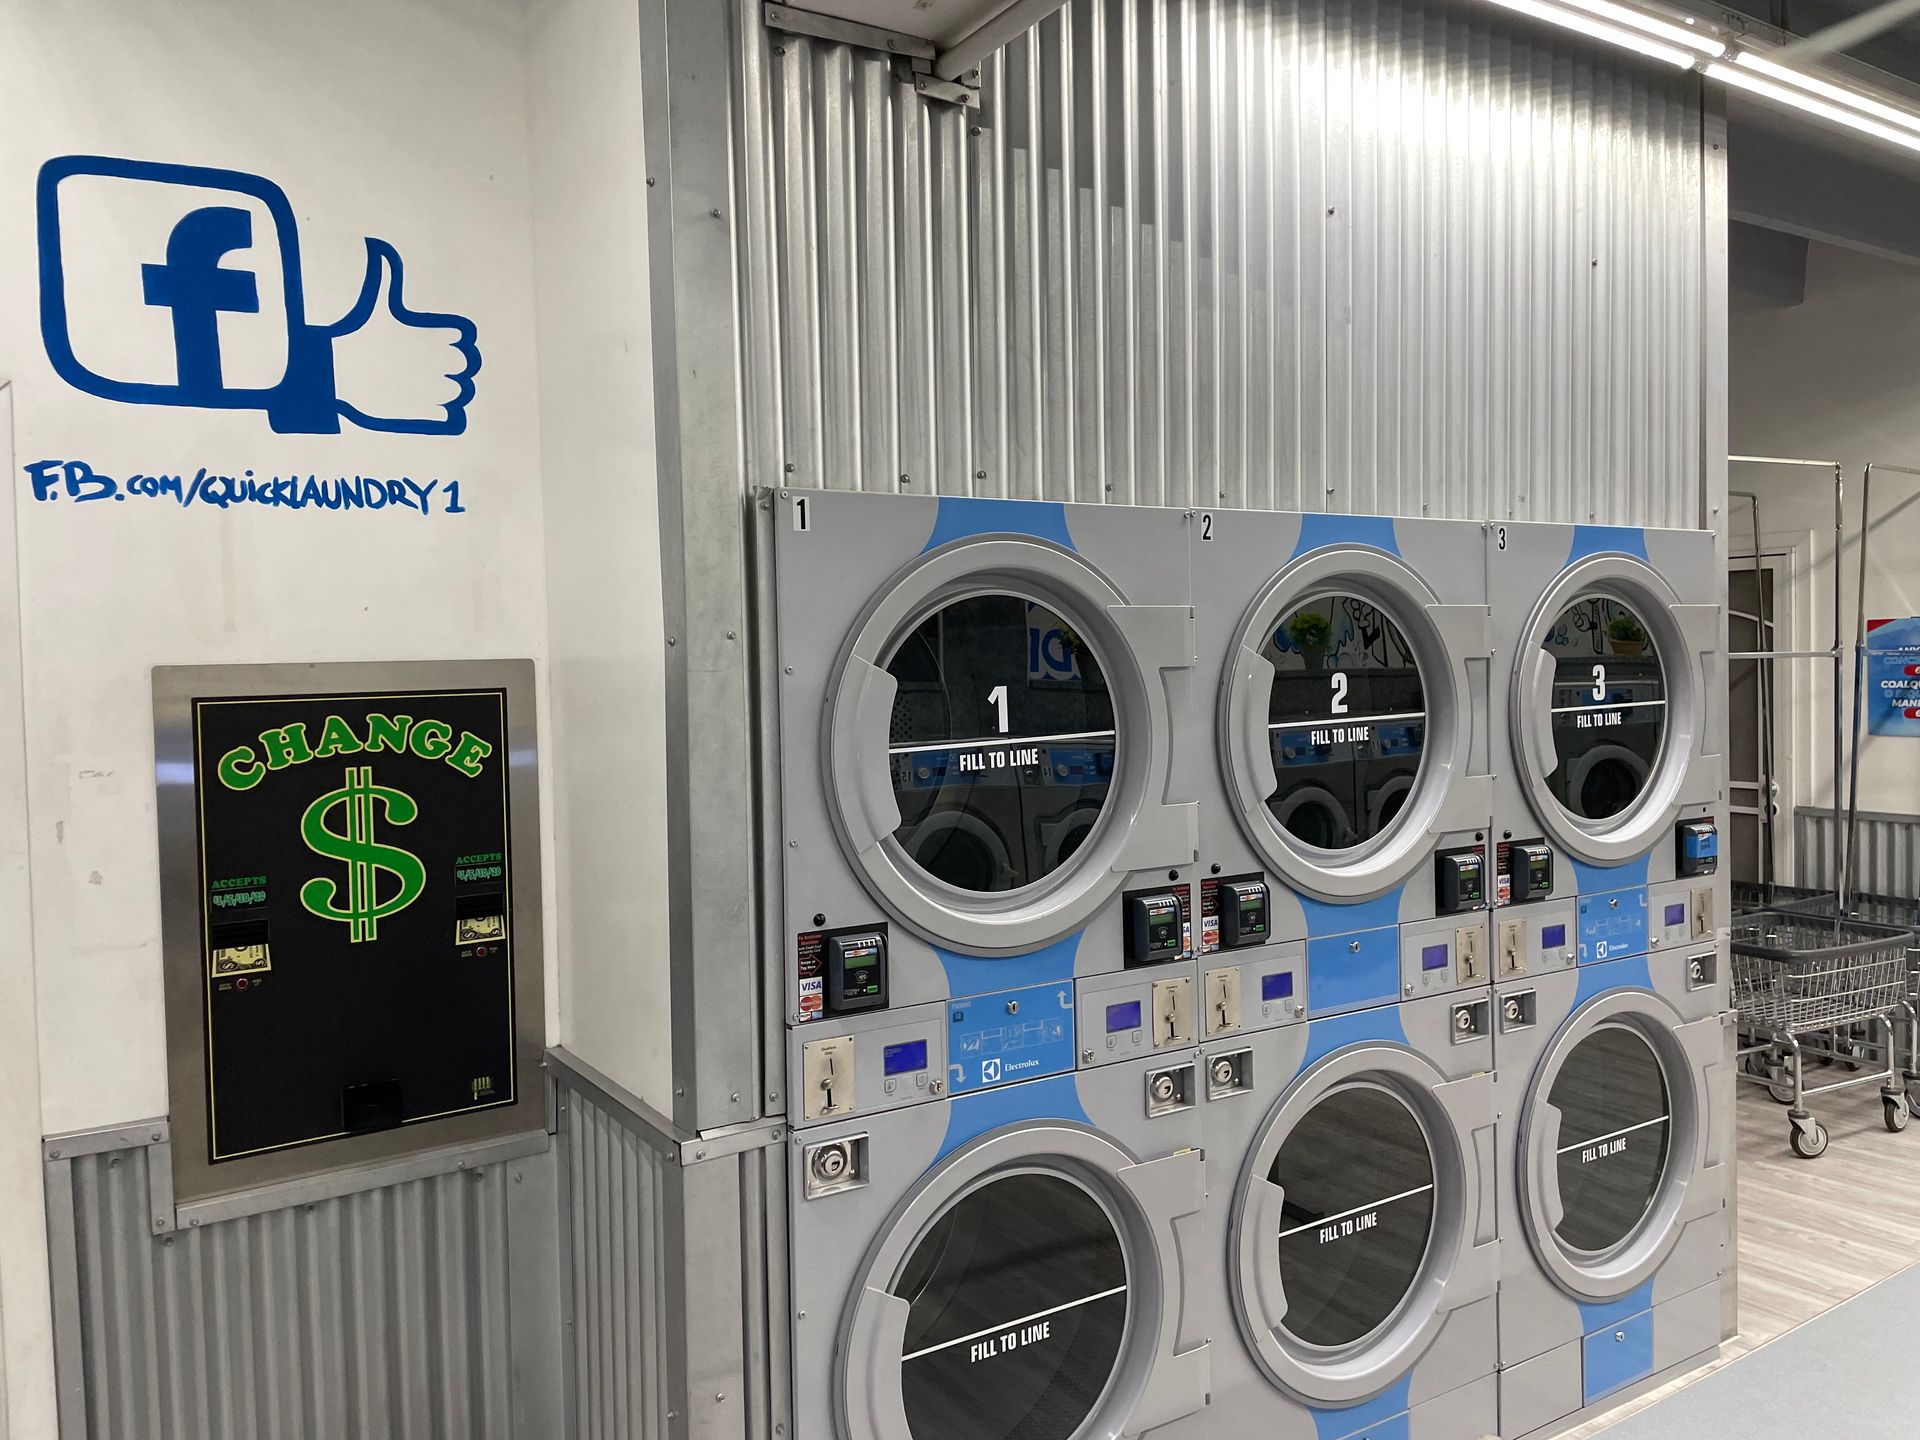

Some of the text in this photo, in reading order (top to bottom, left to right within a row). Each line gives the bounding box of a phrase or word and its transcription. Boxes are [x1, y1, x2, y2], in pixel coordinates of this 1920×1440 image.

[796, 498, 806, 530] 1
[1202, 514, 1212, 541] 2
[1498, 527, 1506, 550] 3
[1331, 672, 1348, 714] 2
[1592, 664, 1606, 701] 3
[1880, 680, 1920, 689] COALQ
[987, 685, 1009, 733] 1
[1577, 712, 1622, 728] FILL TO LINE
[1311, 726, 1369, 746] FILL TO LINE
[218, 714, 492, 790] CHANGE
[959, 748, 1039, 772] FILL TO LINE
[456, 853, 502, 865] ACCEPTS
[212, 876, 266, 889] ACCEPTS
[1203, 918, 1218, 928] VISA
[801, 980, 822, 992] VISA
[1004, 1059, 1040, 1072] Electrolux
[1582, 1137, 1626, 1163] FILL TO LINE
[1320, 1212, 1377, 1244] FILL TO LINE
[970, 1321, 1050, 1363] FILL TO LINE
